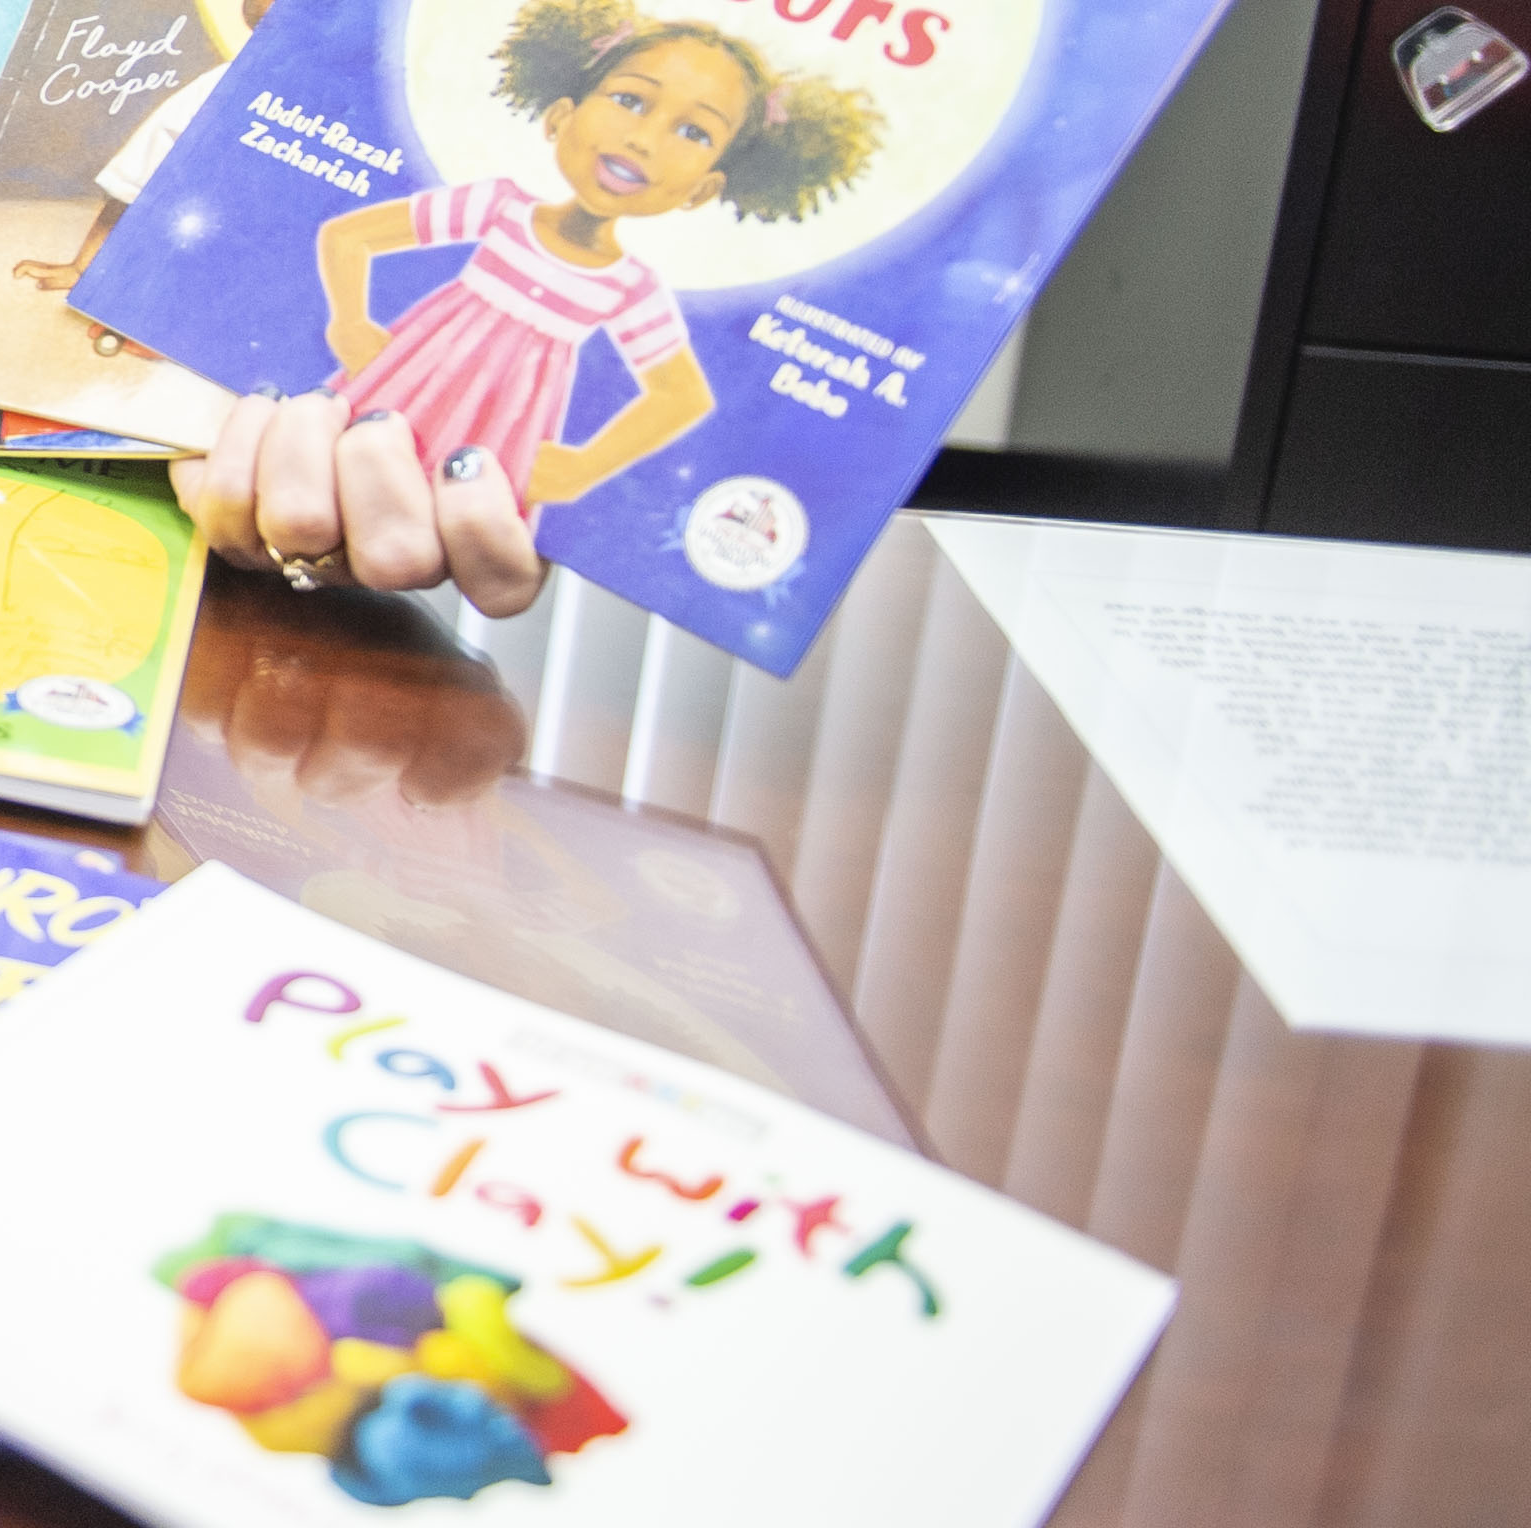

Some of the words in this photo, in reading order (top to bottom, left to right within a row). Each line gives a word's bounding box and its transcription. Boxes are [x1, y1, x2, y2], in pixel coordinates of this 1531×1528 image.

[56, 14, 189, 76] Floyd
[39, 62, 180, 115] Cooper
[239, 120, 372, 198] Zachariah
[246, 90, 404, 176] Abdul-Razak
[243, 968, 563, 1115] Play
[615, 1134, 942, 1320] with
[321, 1110, 761, 1313] Clay!
